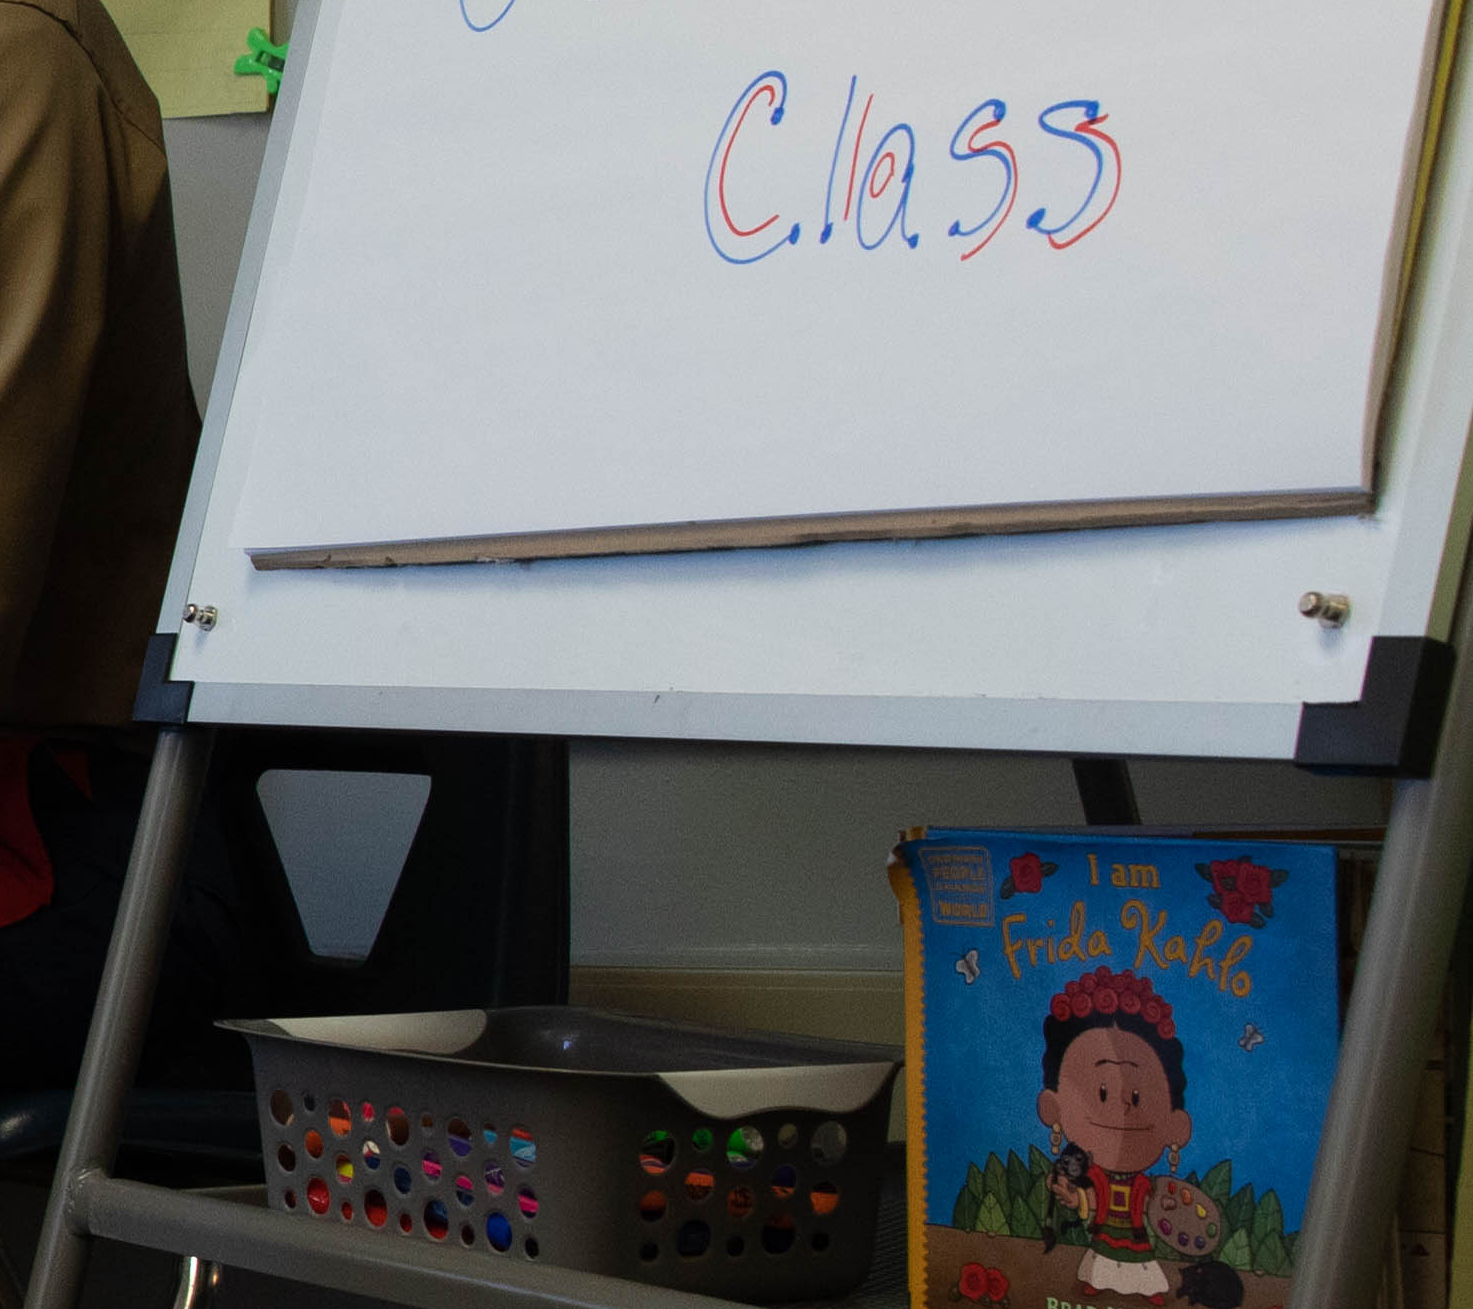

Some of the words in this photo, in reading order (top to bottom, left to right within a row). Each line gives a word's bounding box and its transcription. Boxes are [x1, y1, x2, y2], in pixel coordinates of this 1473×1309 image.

[705, 68, 1122, 265] Class
[1087, 852, 1100, 887] I
[1109, 862, 1162, 890] am
[1001, 899, 1112, 979] Frida
[1121, 897, 1255, 999] Kahlo
